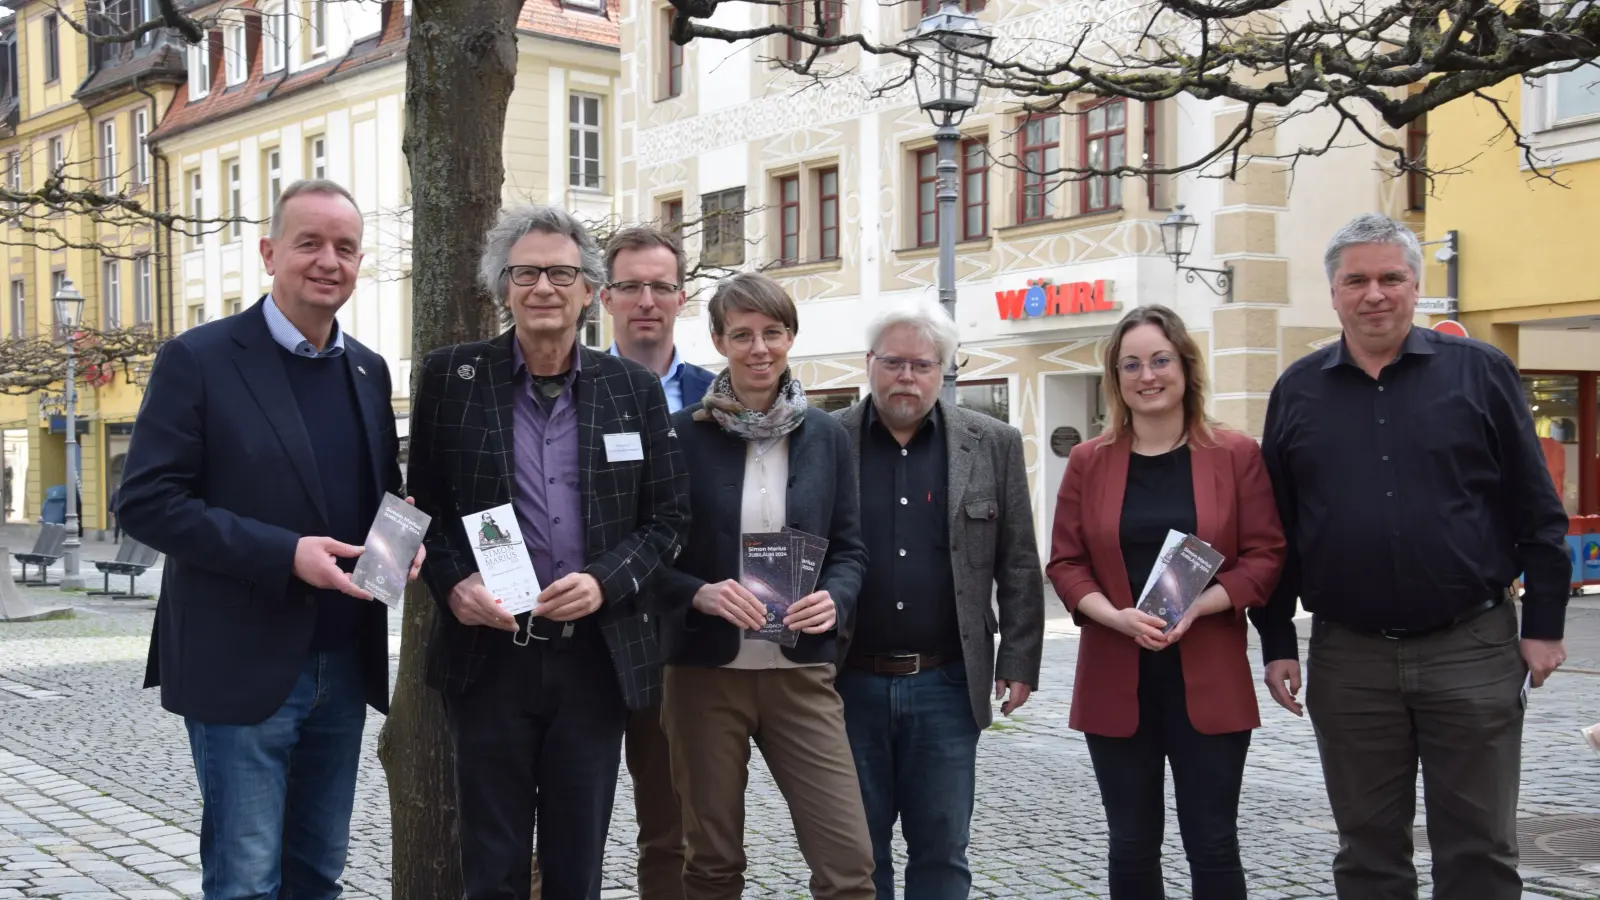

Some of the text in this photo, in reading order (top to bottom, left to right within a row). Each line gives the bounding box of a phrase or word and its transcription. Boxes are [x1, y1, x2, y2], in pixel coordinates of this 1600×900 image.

[995, 278, 1113, 320] WÖHRL
[484, 544, 515, 559] SIMON
[485, 552, 518, 567] MARIUS
